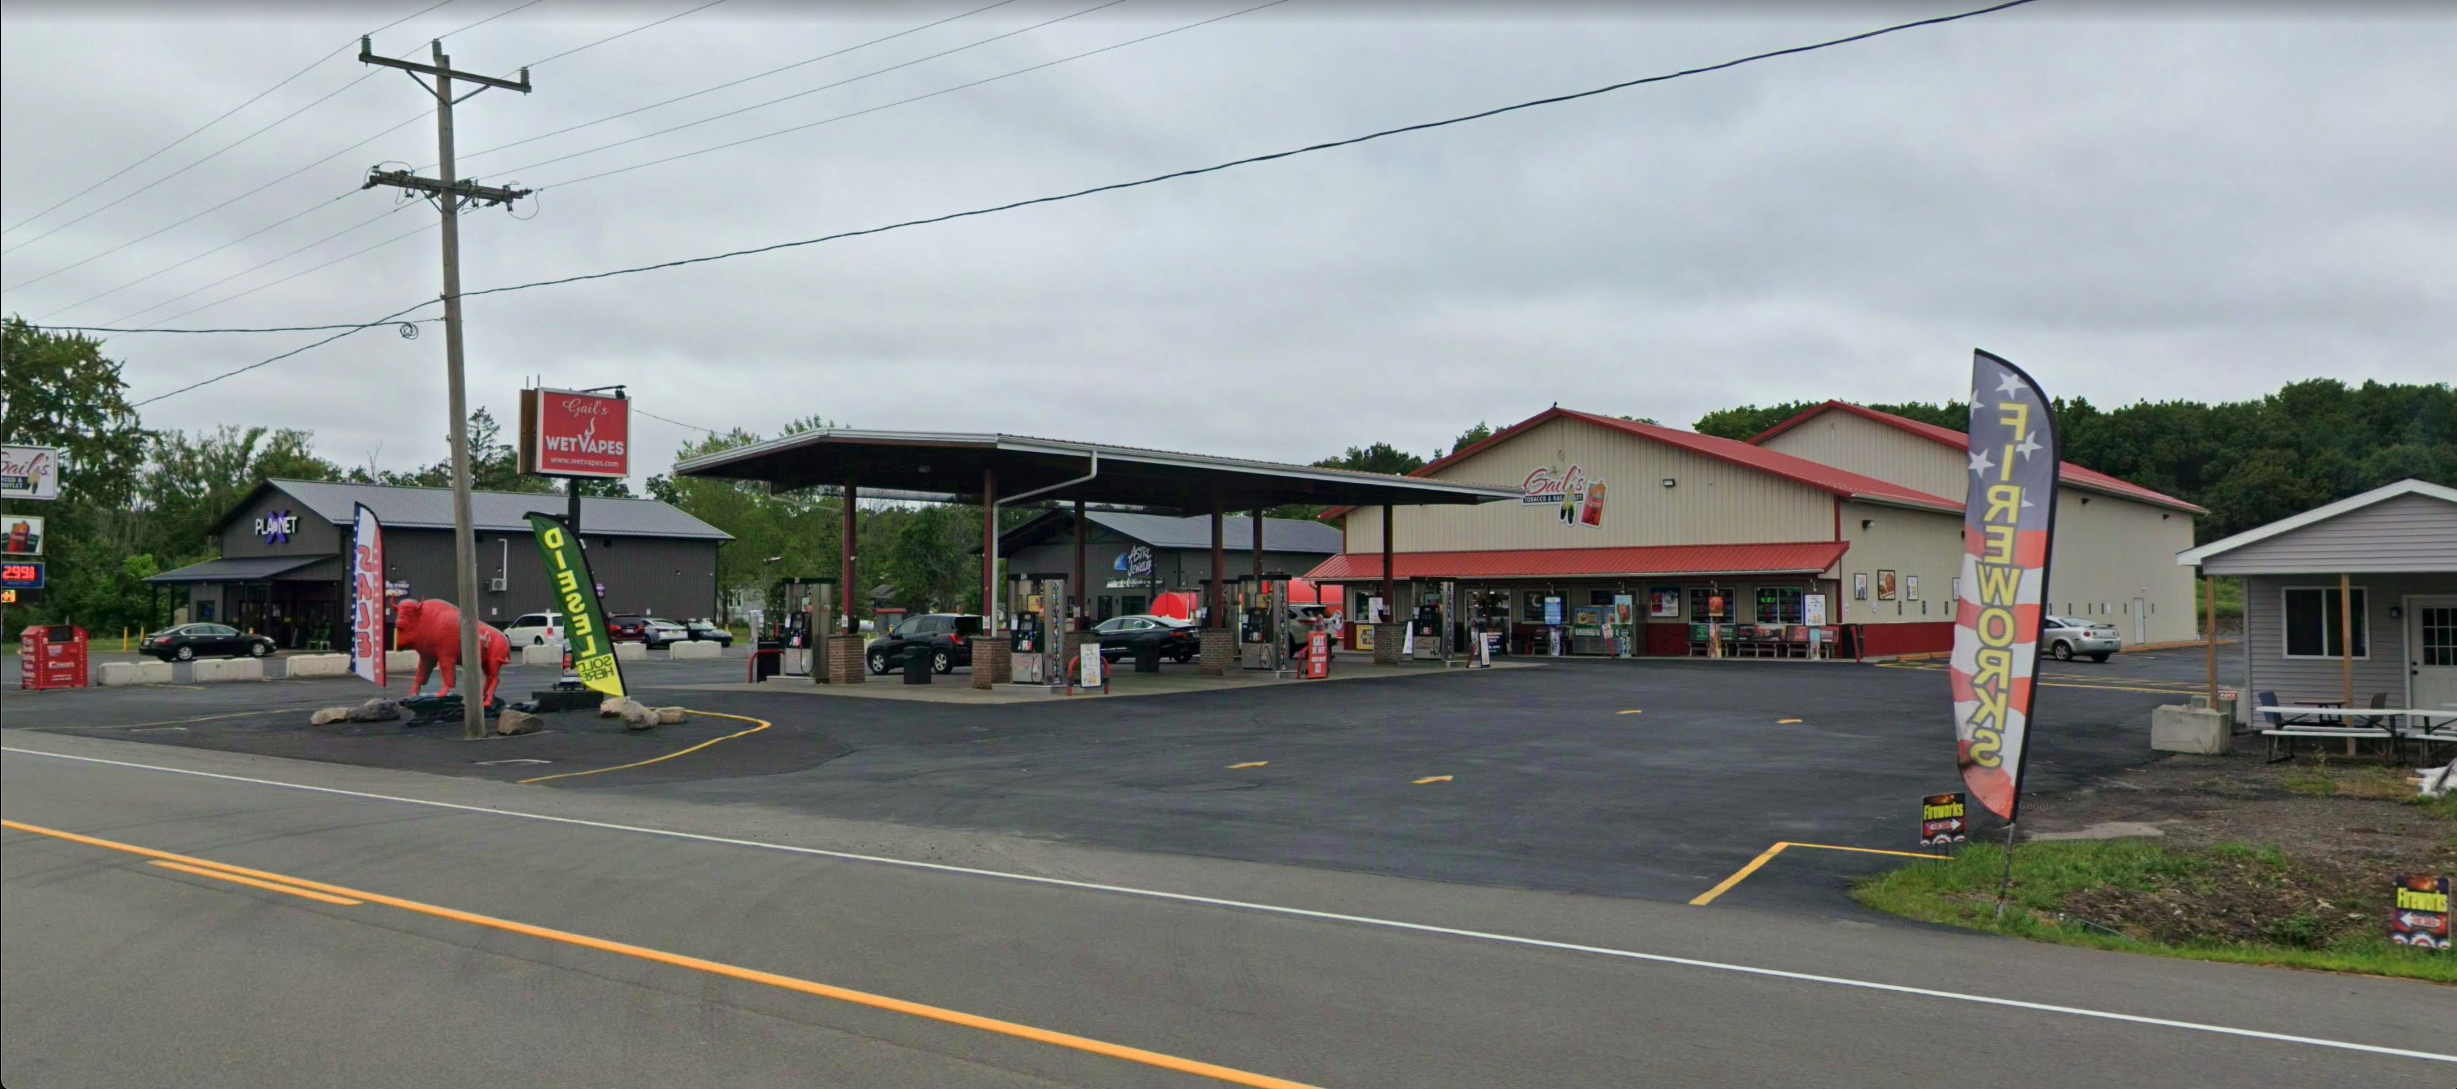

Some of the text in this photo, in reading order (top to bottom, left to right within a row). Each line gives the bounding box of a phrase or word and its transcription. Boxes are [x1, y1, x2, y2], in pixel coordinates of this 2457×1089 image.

[562, 398, 609, 418] Gail's
[545, 434, 625, 455] WETVAPES
[550, 457, 619, 468] www.wetvapes.com
[1523, 465, 1585, 495] Gail's
[1923, 801, 1964, 821] Fireworks
[2396, 887, 2448, 912] Fireworks
